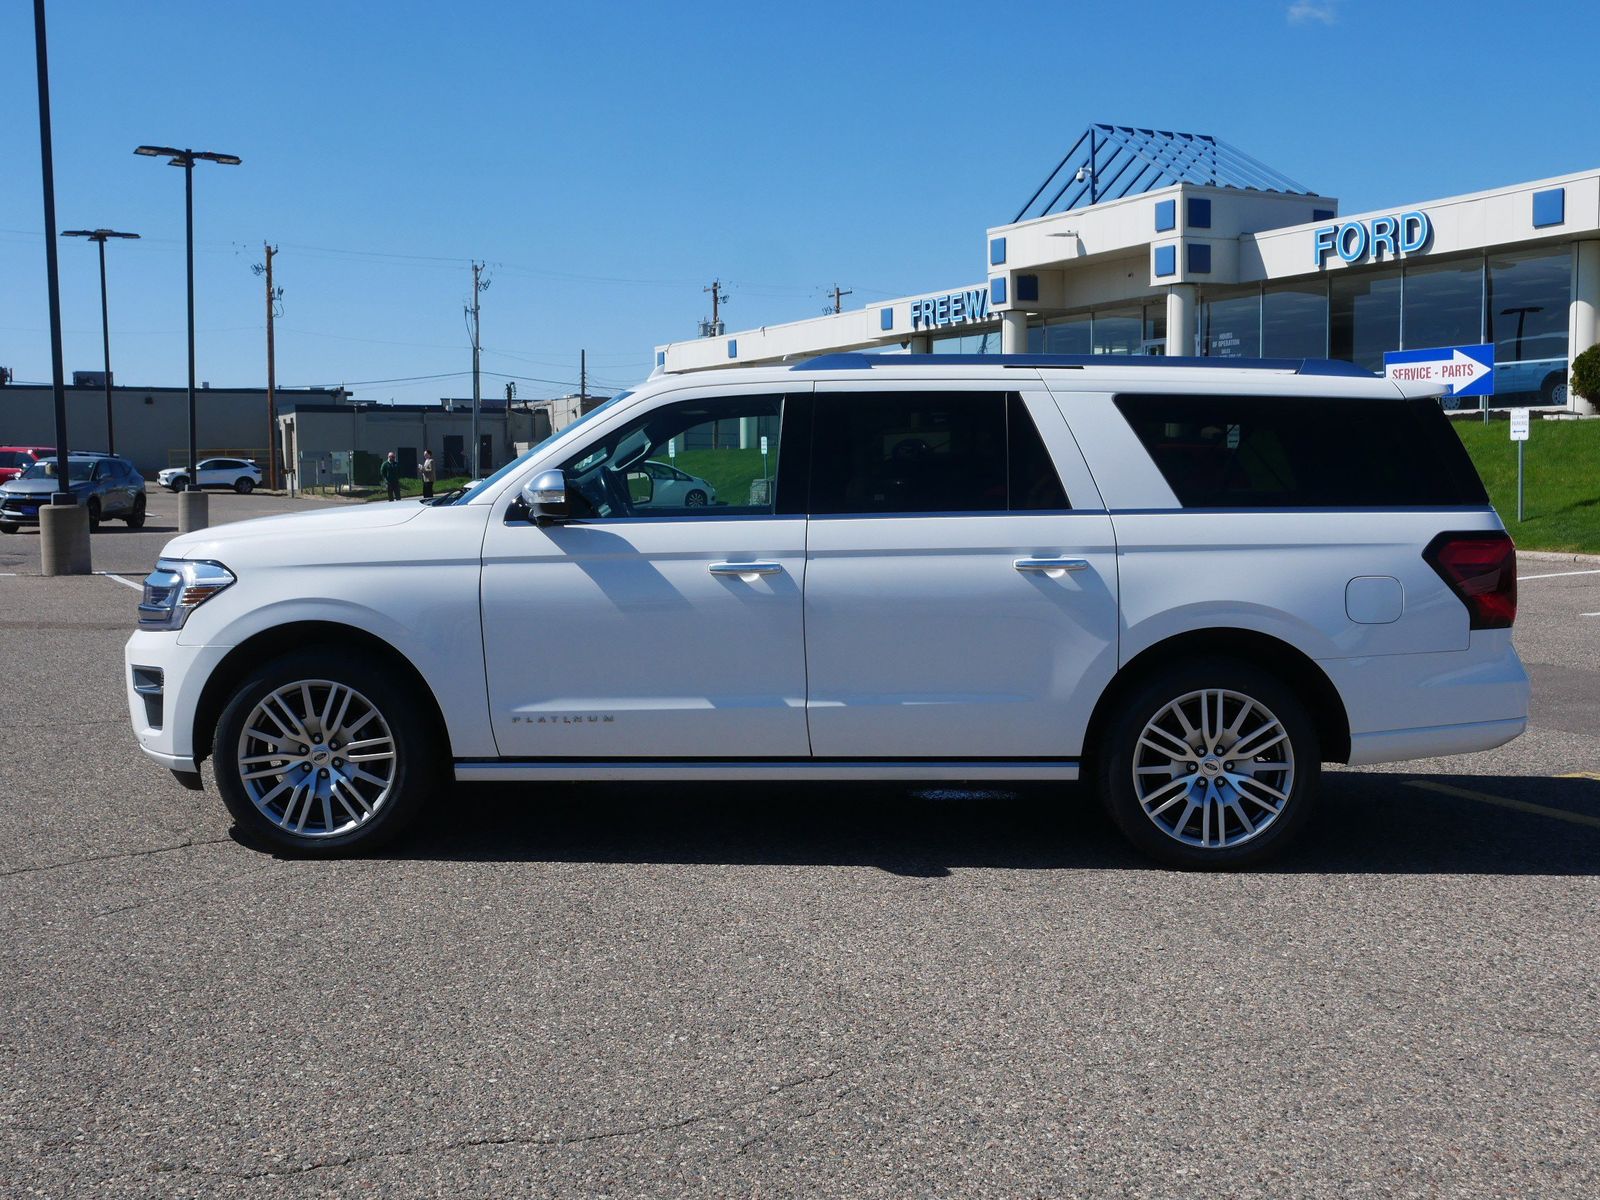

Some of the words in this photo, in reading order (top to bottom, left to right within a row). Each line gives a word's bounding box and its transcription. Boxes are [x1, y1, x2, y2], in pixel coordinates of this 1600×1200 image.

[1314, 210, 1429, 266] FORD
[1392, 366, 1432, 380] SERVICE
[1441, 363, 1474, 378] PARTS
